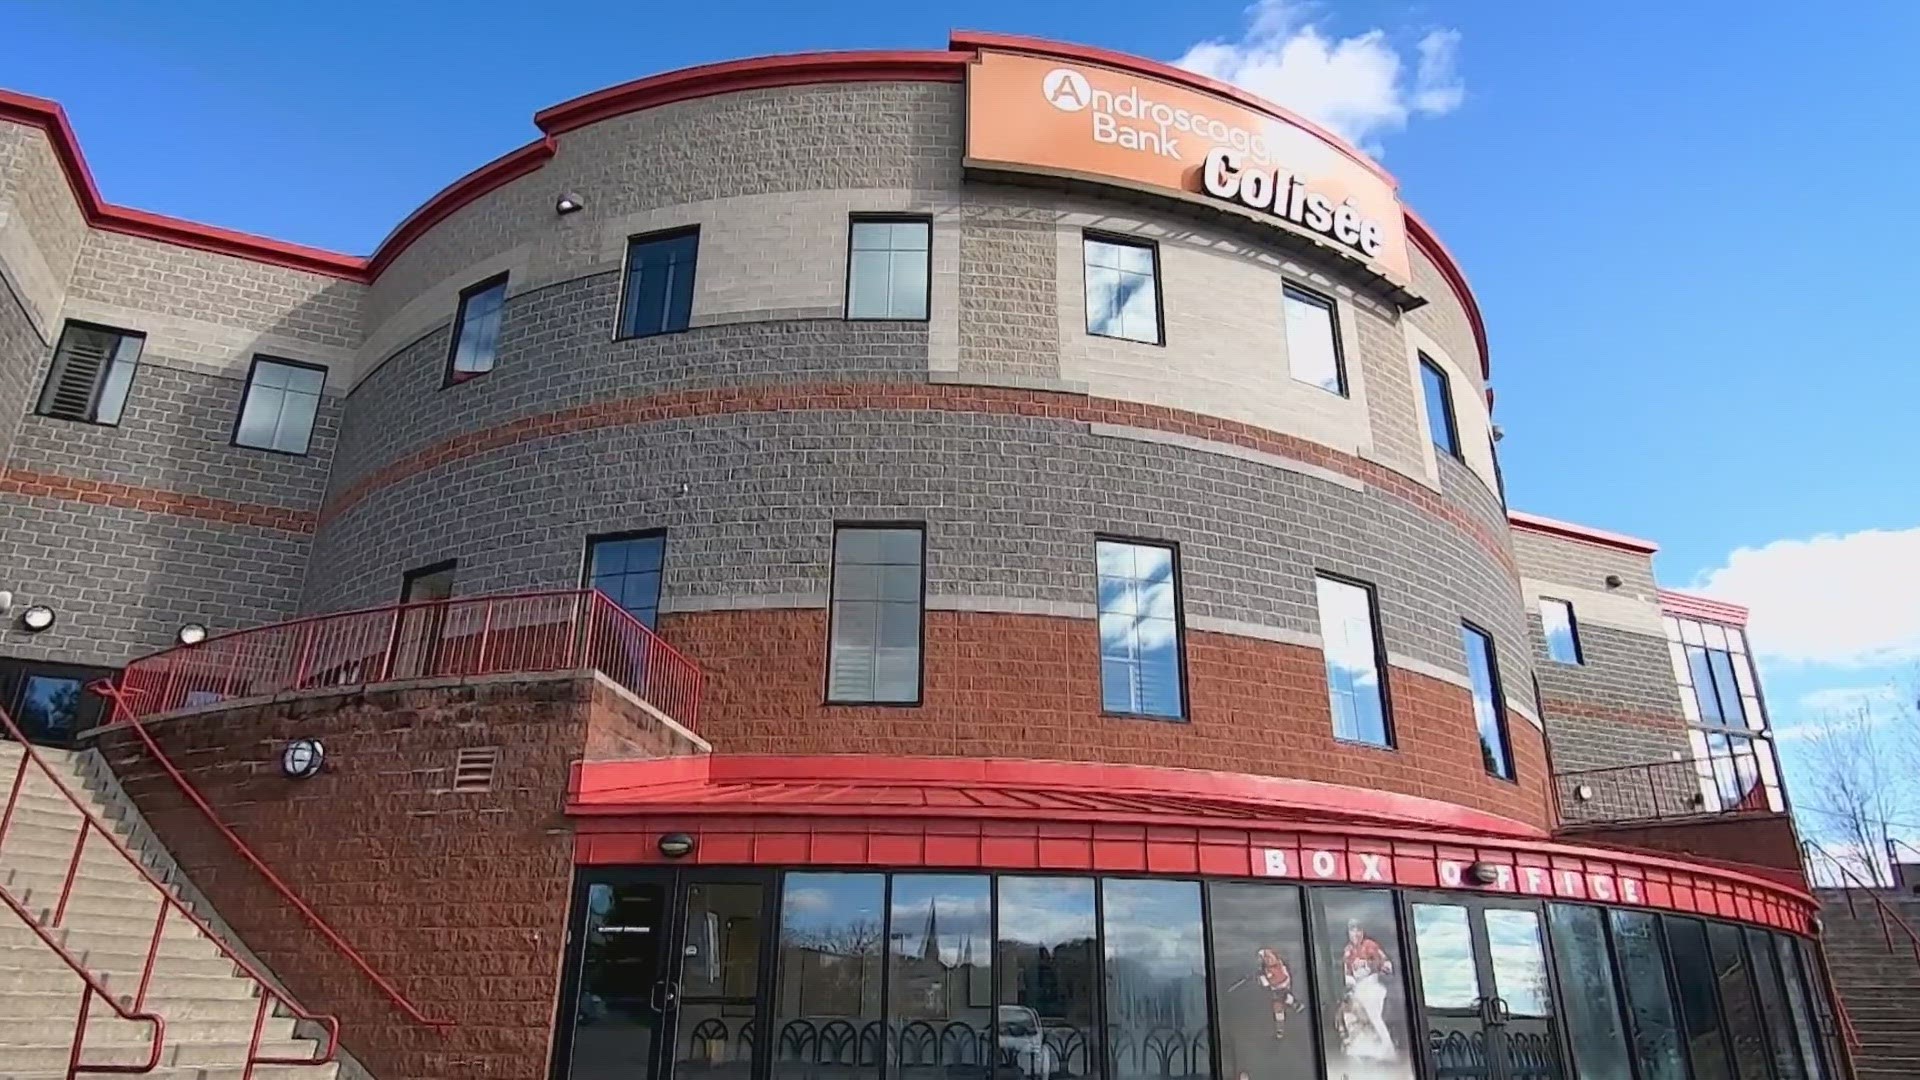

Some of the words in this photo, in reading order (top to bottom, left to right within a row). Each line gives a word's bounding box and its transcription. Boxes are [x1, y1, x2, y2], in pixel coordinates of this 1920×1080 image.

[1043, 68, 1276, 168] Androscogg
[1093, 111, 1182, 160] Bank
[1204, 146, 1384, 258] Colisée
[1263, 849, 1383, 881] BOX
[1440, 859, 1640, 902] OFFICE
